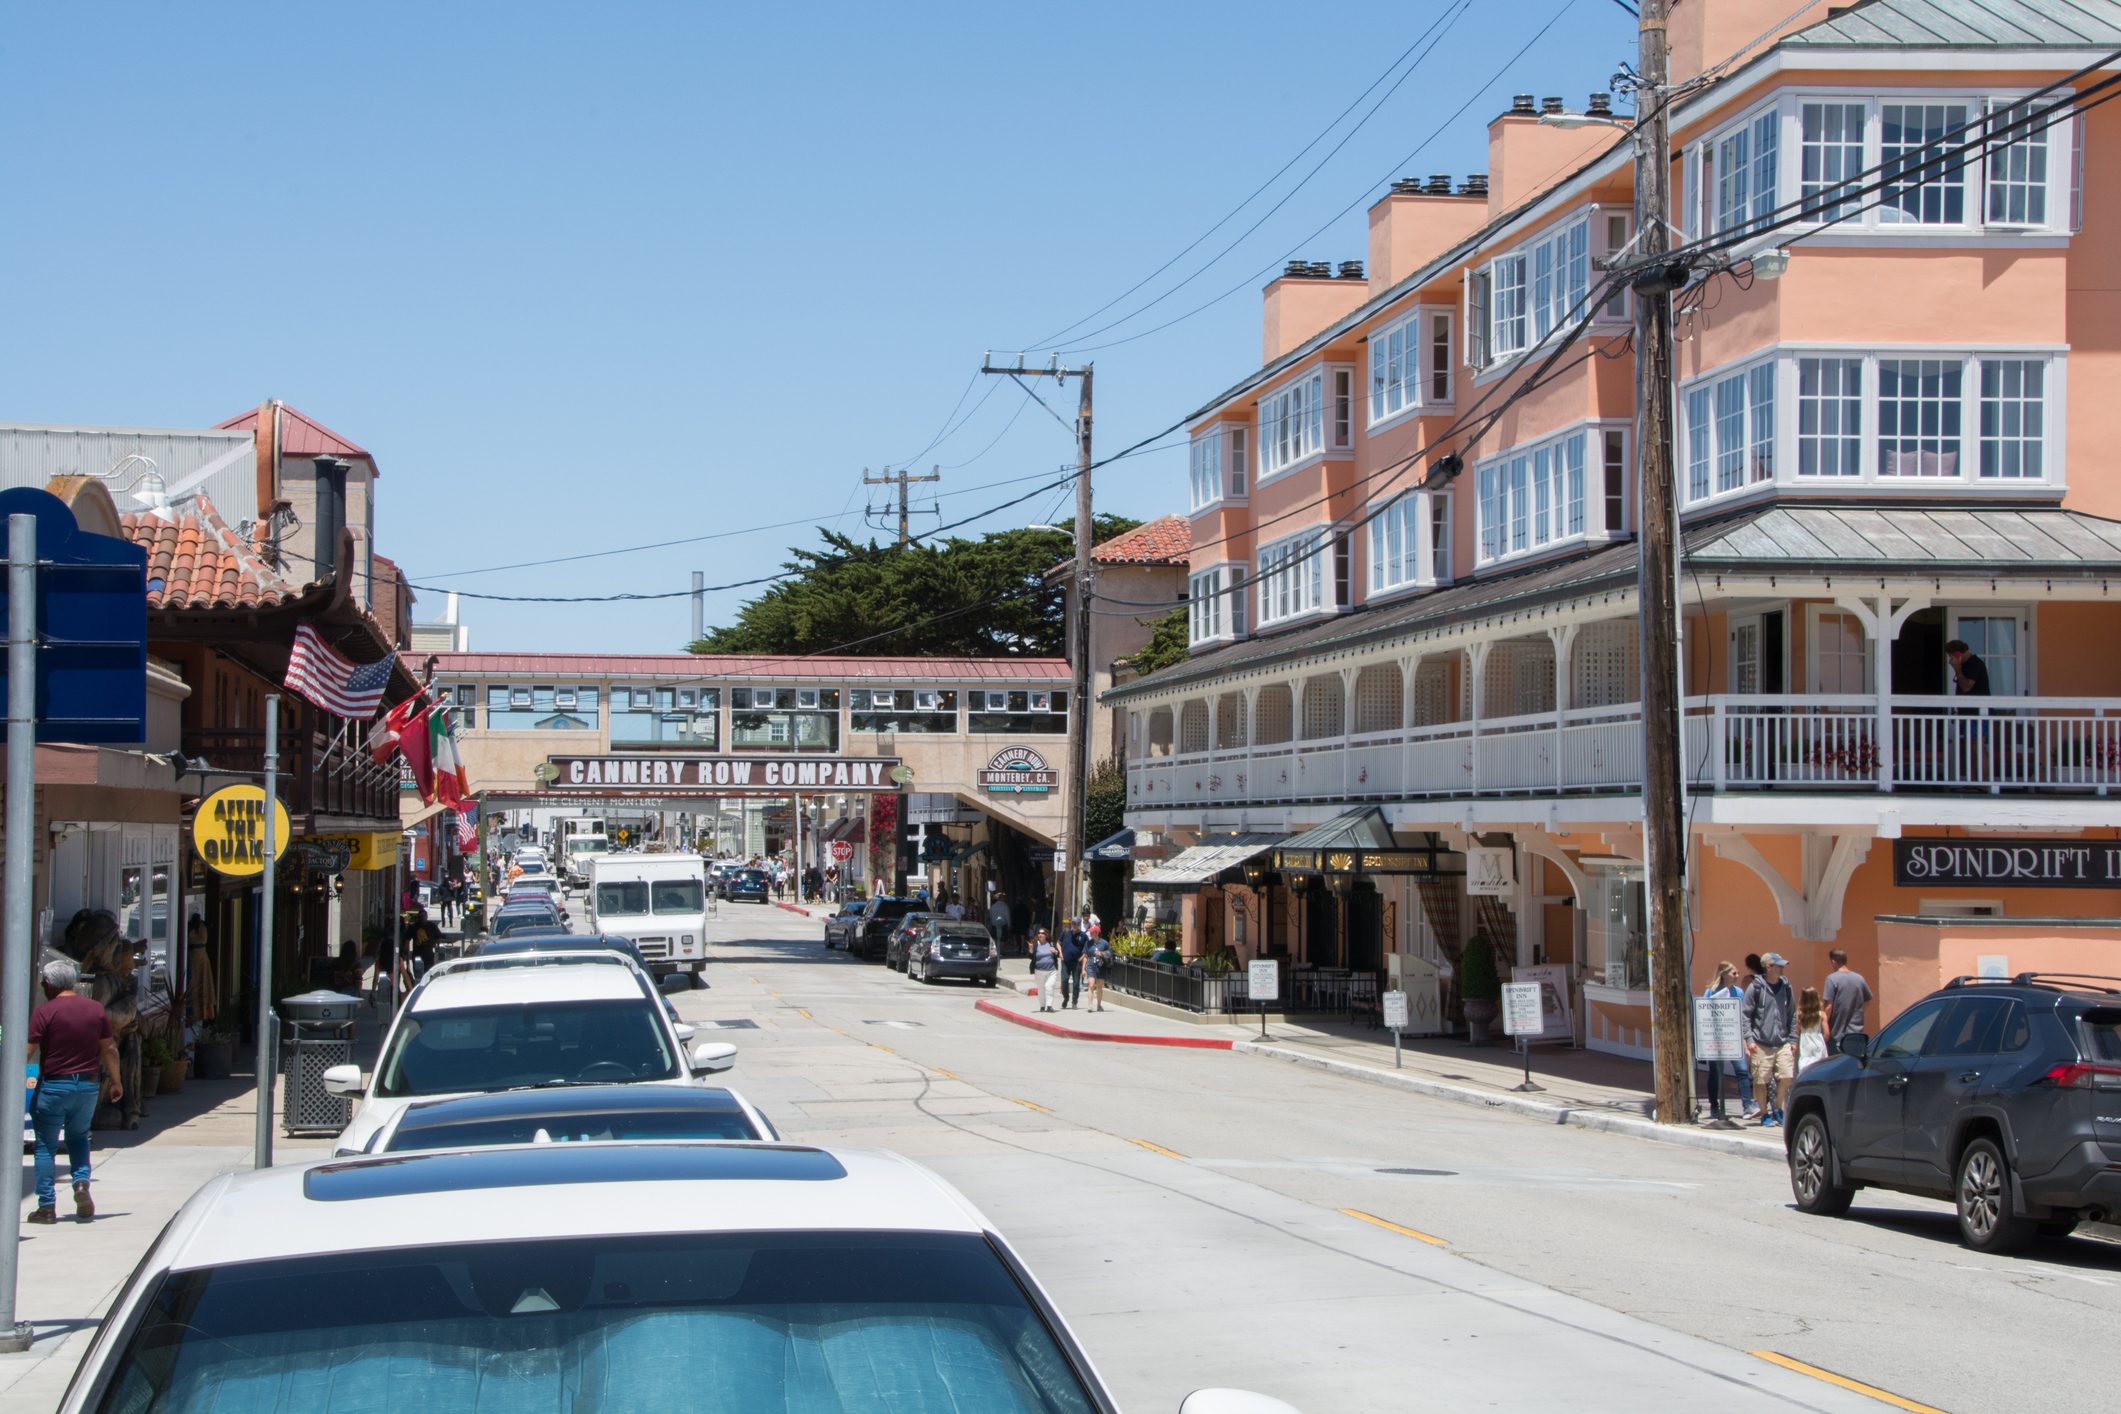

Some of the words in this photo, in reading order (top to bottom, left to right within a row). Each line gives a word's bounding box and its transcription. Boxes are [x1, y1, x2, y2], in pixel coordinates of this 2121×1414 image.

[993, 749, 1028, 769] CANNERY
[1027, 753, 1044, 770] ROW
[570, 760, 685, 784] CANNERY
[698, 761, 752, 785] ROW
[765, 762, 883, 785] COMPANY
[987, 772, 1033, 784] MONTEREY,
[214, 798, 266, 816] AFTER
[538, 797, 558, 806] THE
[561, 797, 605, 806] CLEMENT
[610, 798, 663, 807] MONTEREY
[225, 818, 256, 835] THE
[204, 838, 264, 859] QUAK
[832, 846, 851, 856] STOP
[1363, 856, 1411, 867] SPINDRIFT
[1413, 856, 1428, 867] INN
[1906, 845, 2090, 878] SPINDRIFT
